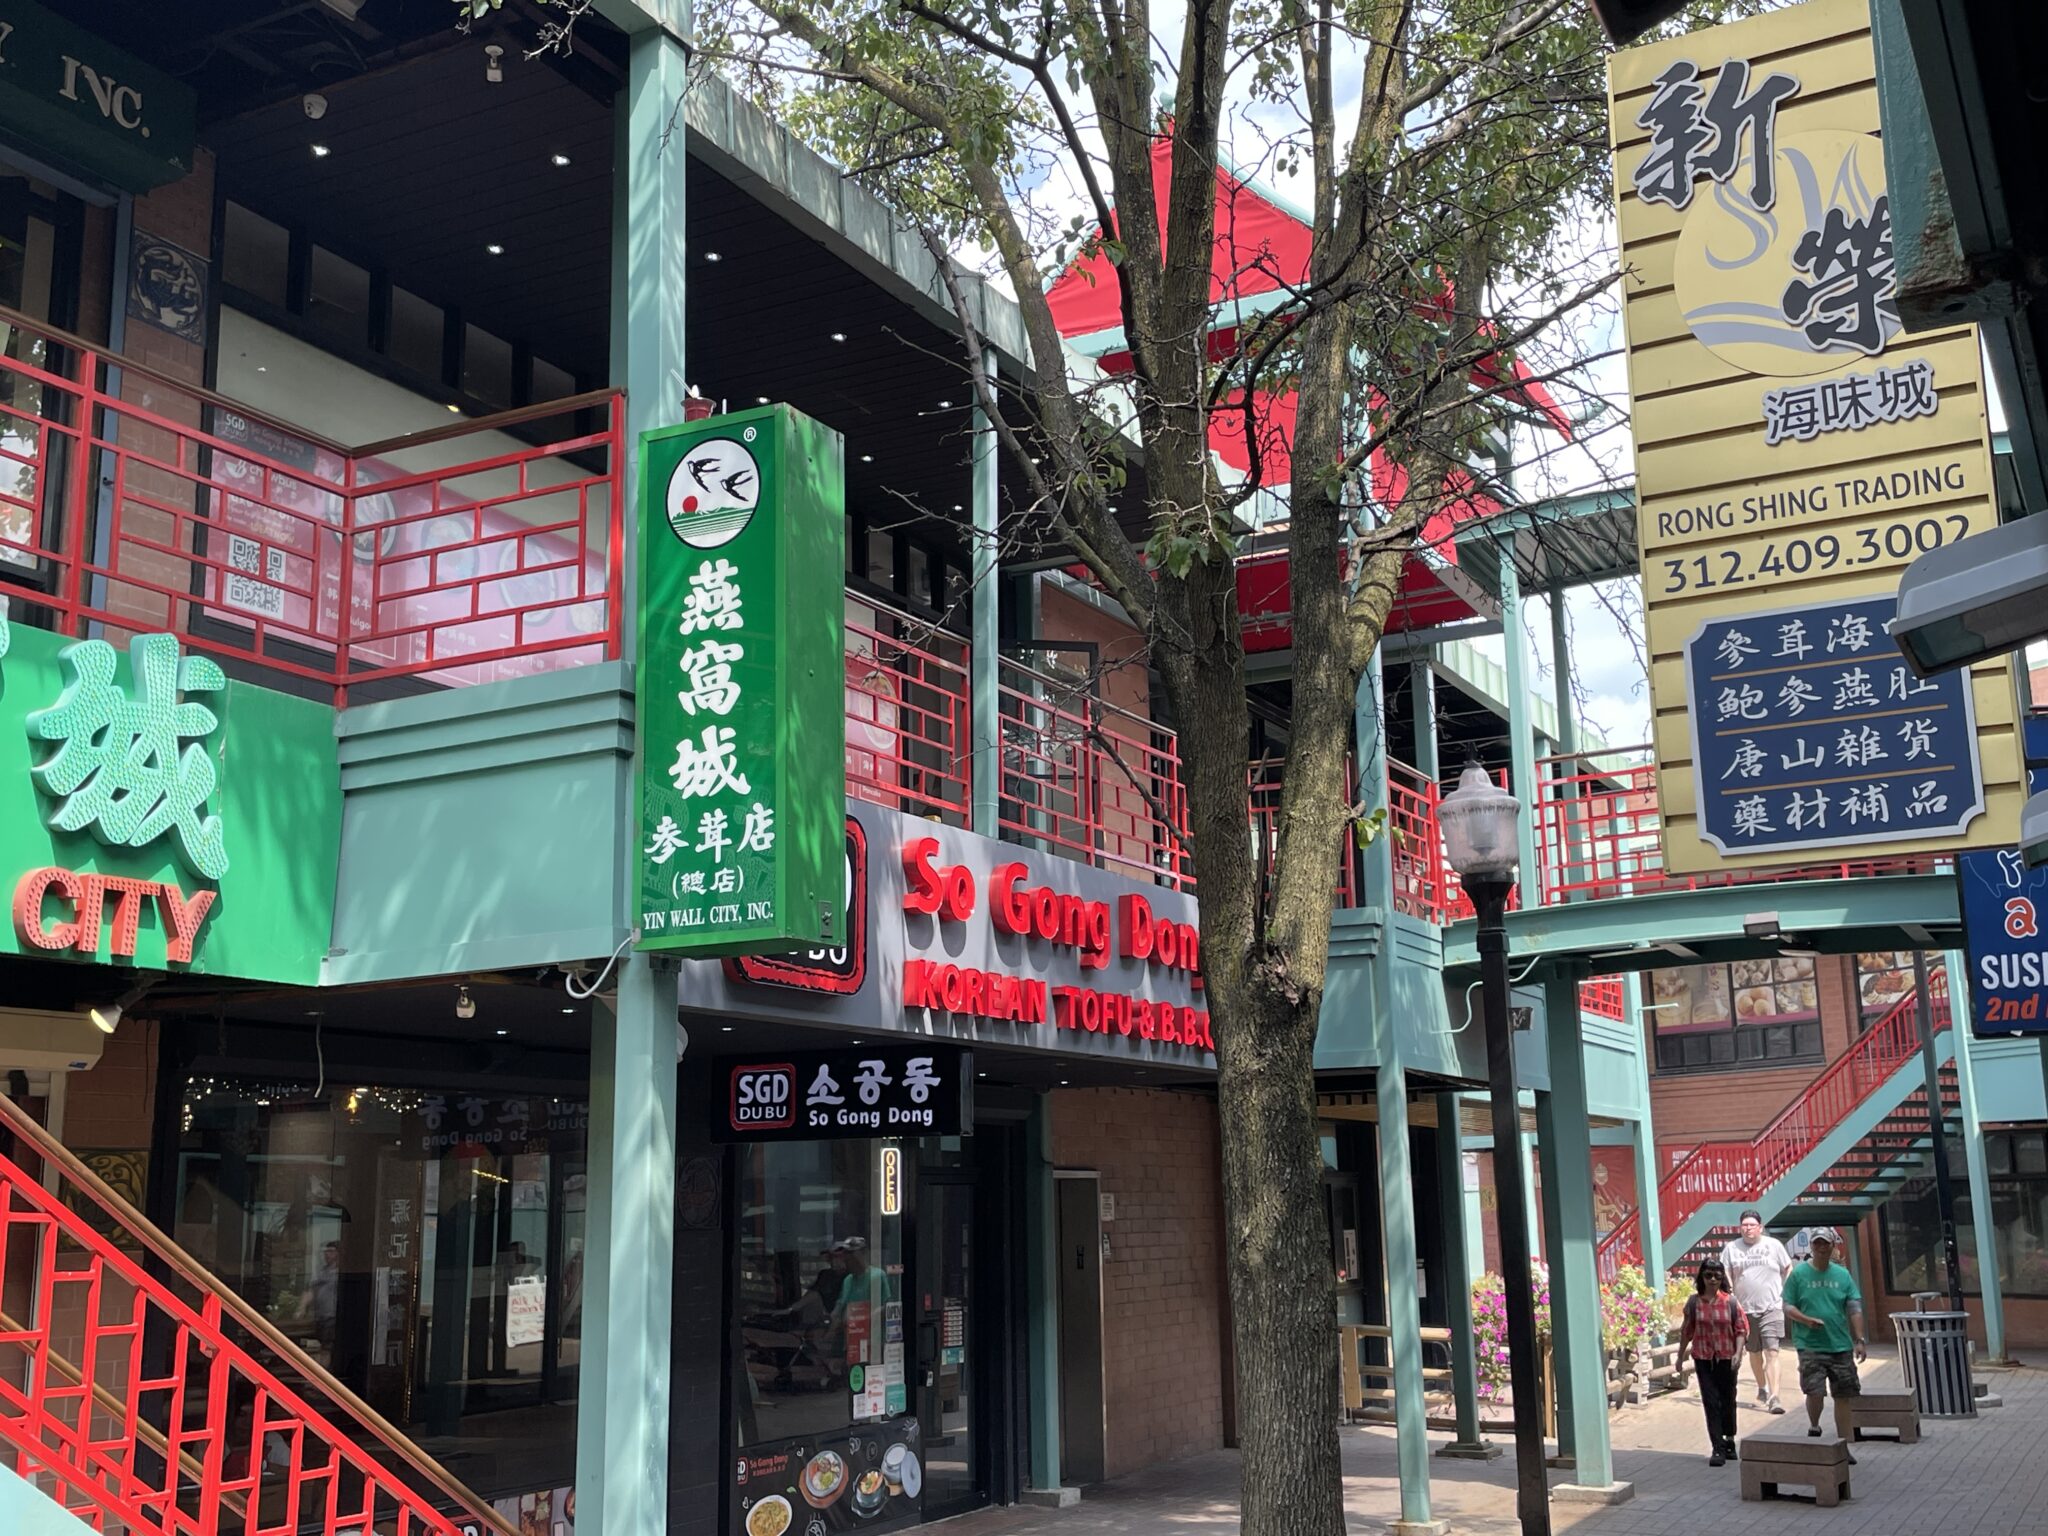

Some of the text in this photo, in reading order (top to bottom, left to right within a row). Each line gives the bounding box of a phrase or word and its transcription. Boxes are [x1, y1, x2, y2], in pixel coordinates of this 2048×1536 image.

[59, 55, 150, 138] INC.
[1634, 59, 1801, 211] 新
[226, 414, 245, 431] SGD
[1763, 361, 1937, 444] 海味城
[1658, 463, 1966, 537] RONG SHING TRADING
[1664, 514, 1970, 593] 312.409.3002
[1715, 614, 1897, 670] 參茸海
[669, 558, 752, 800] 燕窩城
[25, 633, 230, 880] 城
[1720, 718, 1938, 780] 唐山雜貨
[1731, 780, 1948, 837] 藥材補品
[672, 865, 744, 899] (總店)
[12, 866, 217, 963] CITY
[643, 901, 774, 930] YIN WALL CITY, INC.
[903, 837, 1204, 990] So Gong Don
[904, 959, 1047, 1025] KOREAN
[1052, 986, 1132, 1035] TOFU
[1985, 992, 2040, 1022] 2nd
[738, 1073, 789, 1105] SGD
[806, 1057, 942, 1106] 소공동
[739, 1105, 787, 1120] DUBU
[809, 1107, 933, 1128] So Gong Dong
[885, 1151, 896, 1212] OPEN
